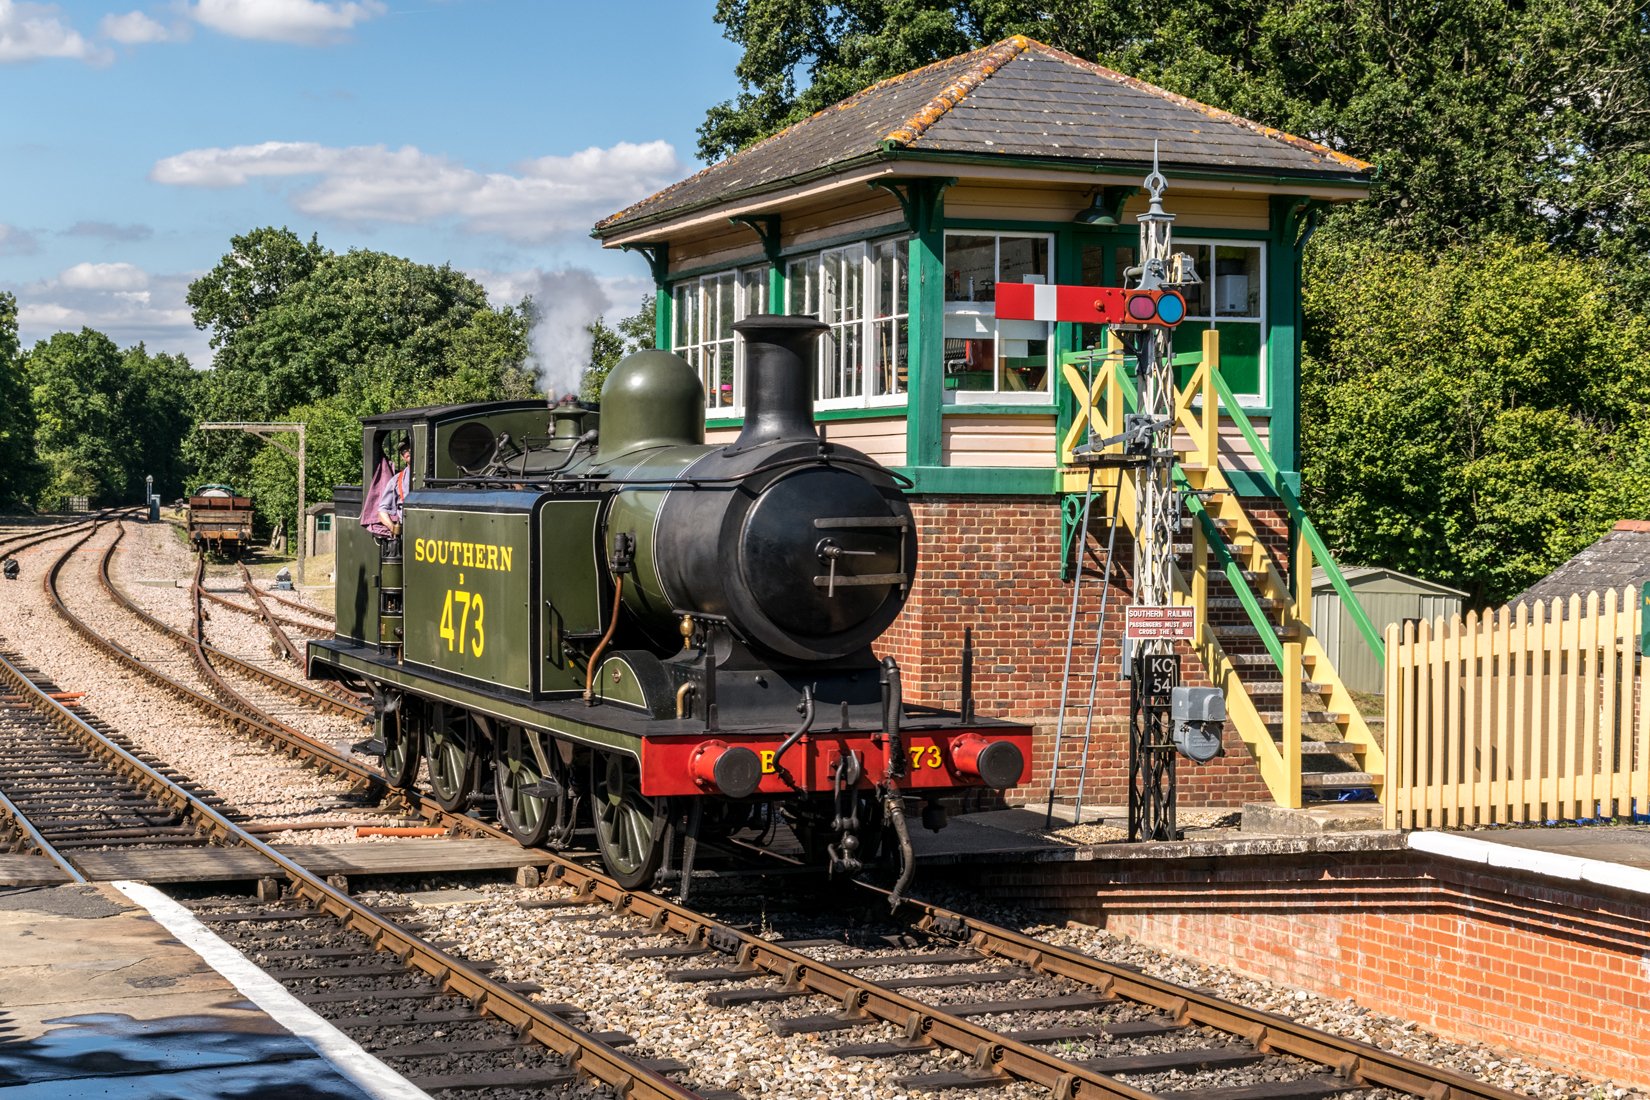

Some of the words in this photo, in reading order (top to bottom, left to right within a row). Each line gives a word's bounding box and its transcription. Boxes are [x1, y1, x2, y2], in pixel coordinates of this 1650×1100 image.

[415, 538, 513, 572] SOUTHERN
[439, 589, 485, 658] 473
[1129, 610, 1164, 618] SOUTHERN
[1167, 610, 1193, 618] RAILWAY
[1152, 678, 1172, 693] 54
[760, 750, 776, 774] B
[908, 745, 942, 769] 73
